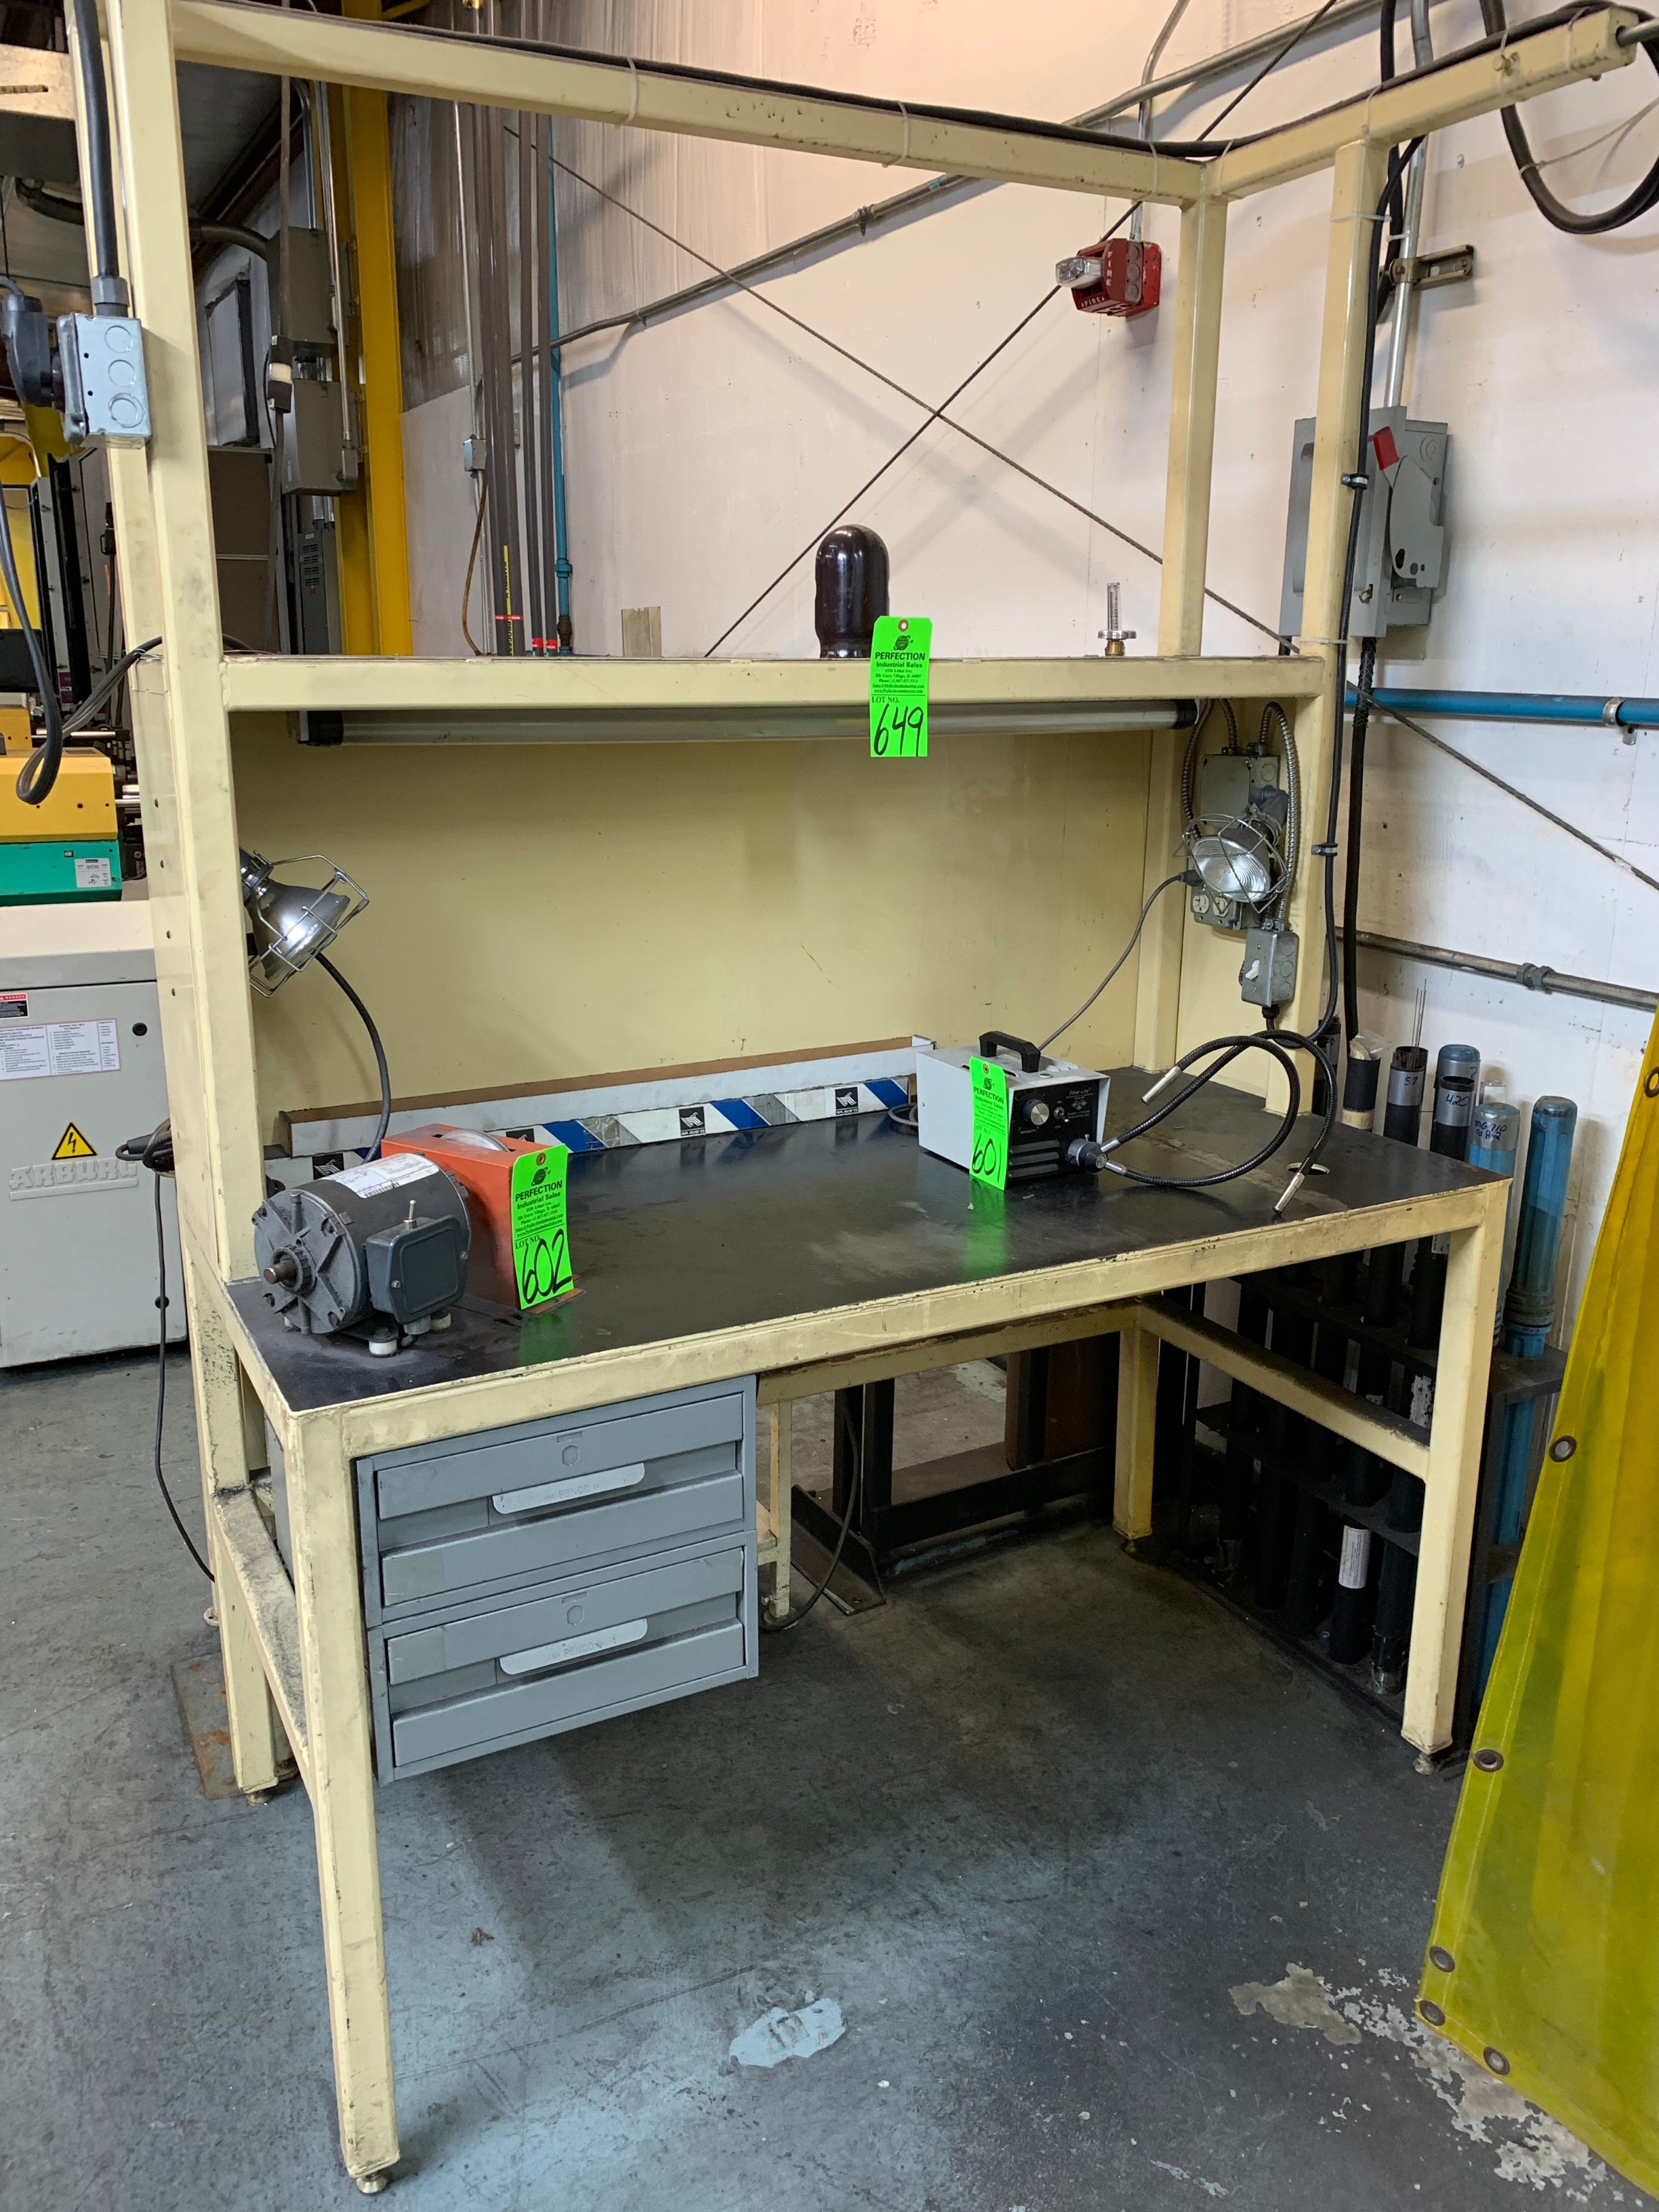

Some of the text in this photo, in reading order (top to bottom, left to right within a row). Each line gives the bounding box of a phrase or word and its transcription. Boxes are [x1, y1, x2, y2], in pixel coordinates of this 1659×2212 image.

[1105, 251, 1113, 286] FIRE
[1084, 297, 1101, 306] FIRE
[875, 652, 926, 660] PERFECTION
[874, 703, 924, 756] 649
[1404, 1077, 1418, 1086] S7
[973, 1086, 1004, 1104] PERFECTION
[1446, 1094, 1471, 1107] 420
[974, 1122, 983, 1130] LOT
[1490, 1123, 1507, 1132] 710
[972, 1133, 1002, 1184] 601
[9, 1157, 138, 1190] ARBURG
[515, 1180, 562, 1202] PERFECTION
[517, 1191, 560, 1210] Industrial Sales
[515, 1238, 529, 1250] LOT
[522, 1228, 572, 1305] 602
[558, 1483, 590, 1498] PENCO
[563, 1641, 594, 1658] PENCO
